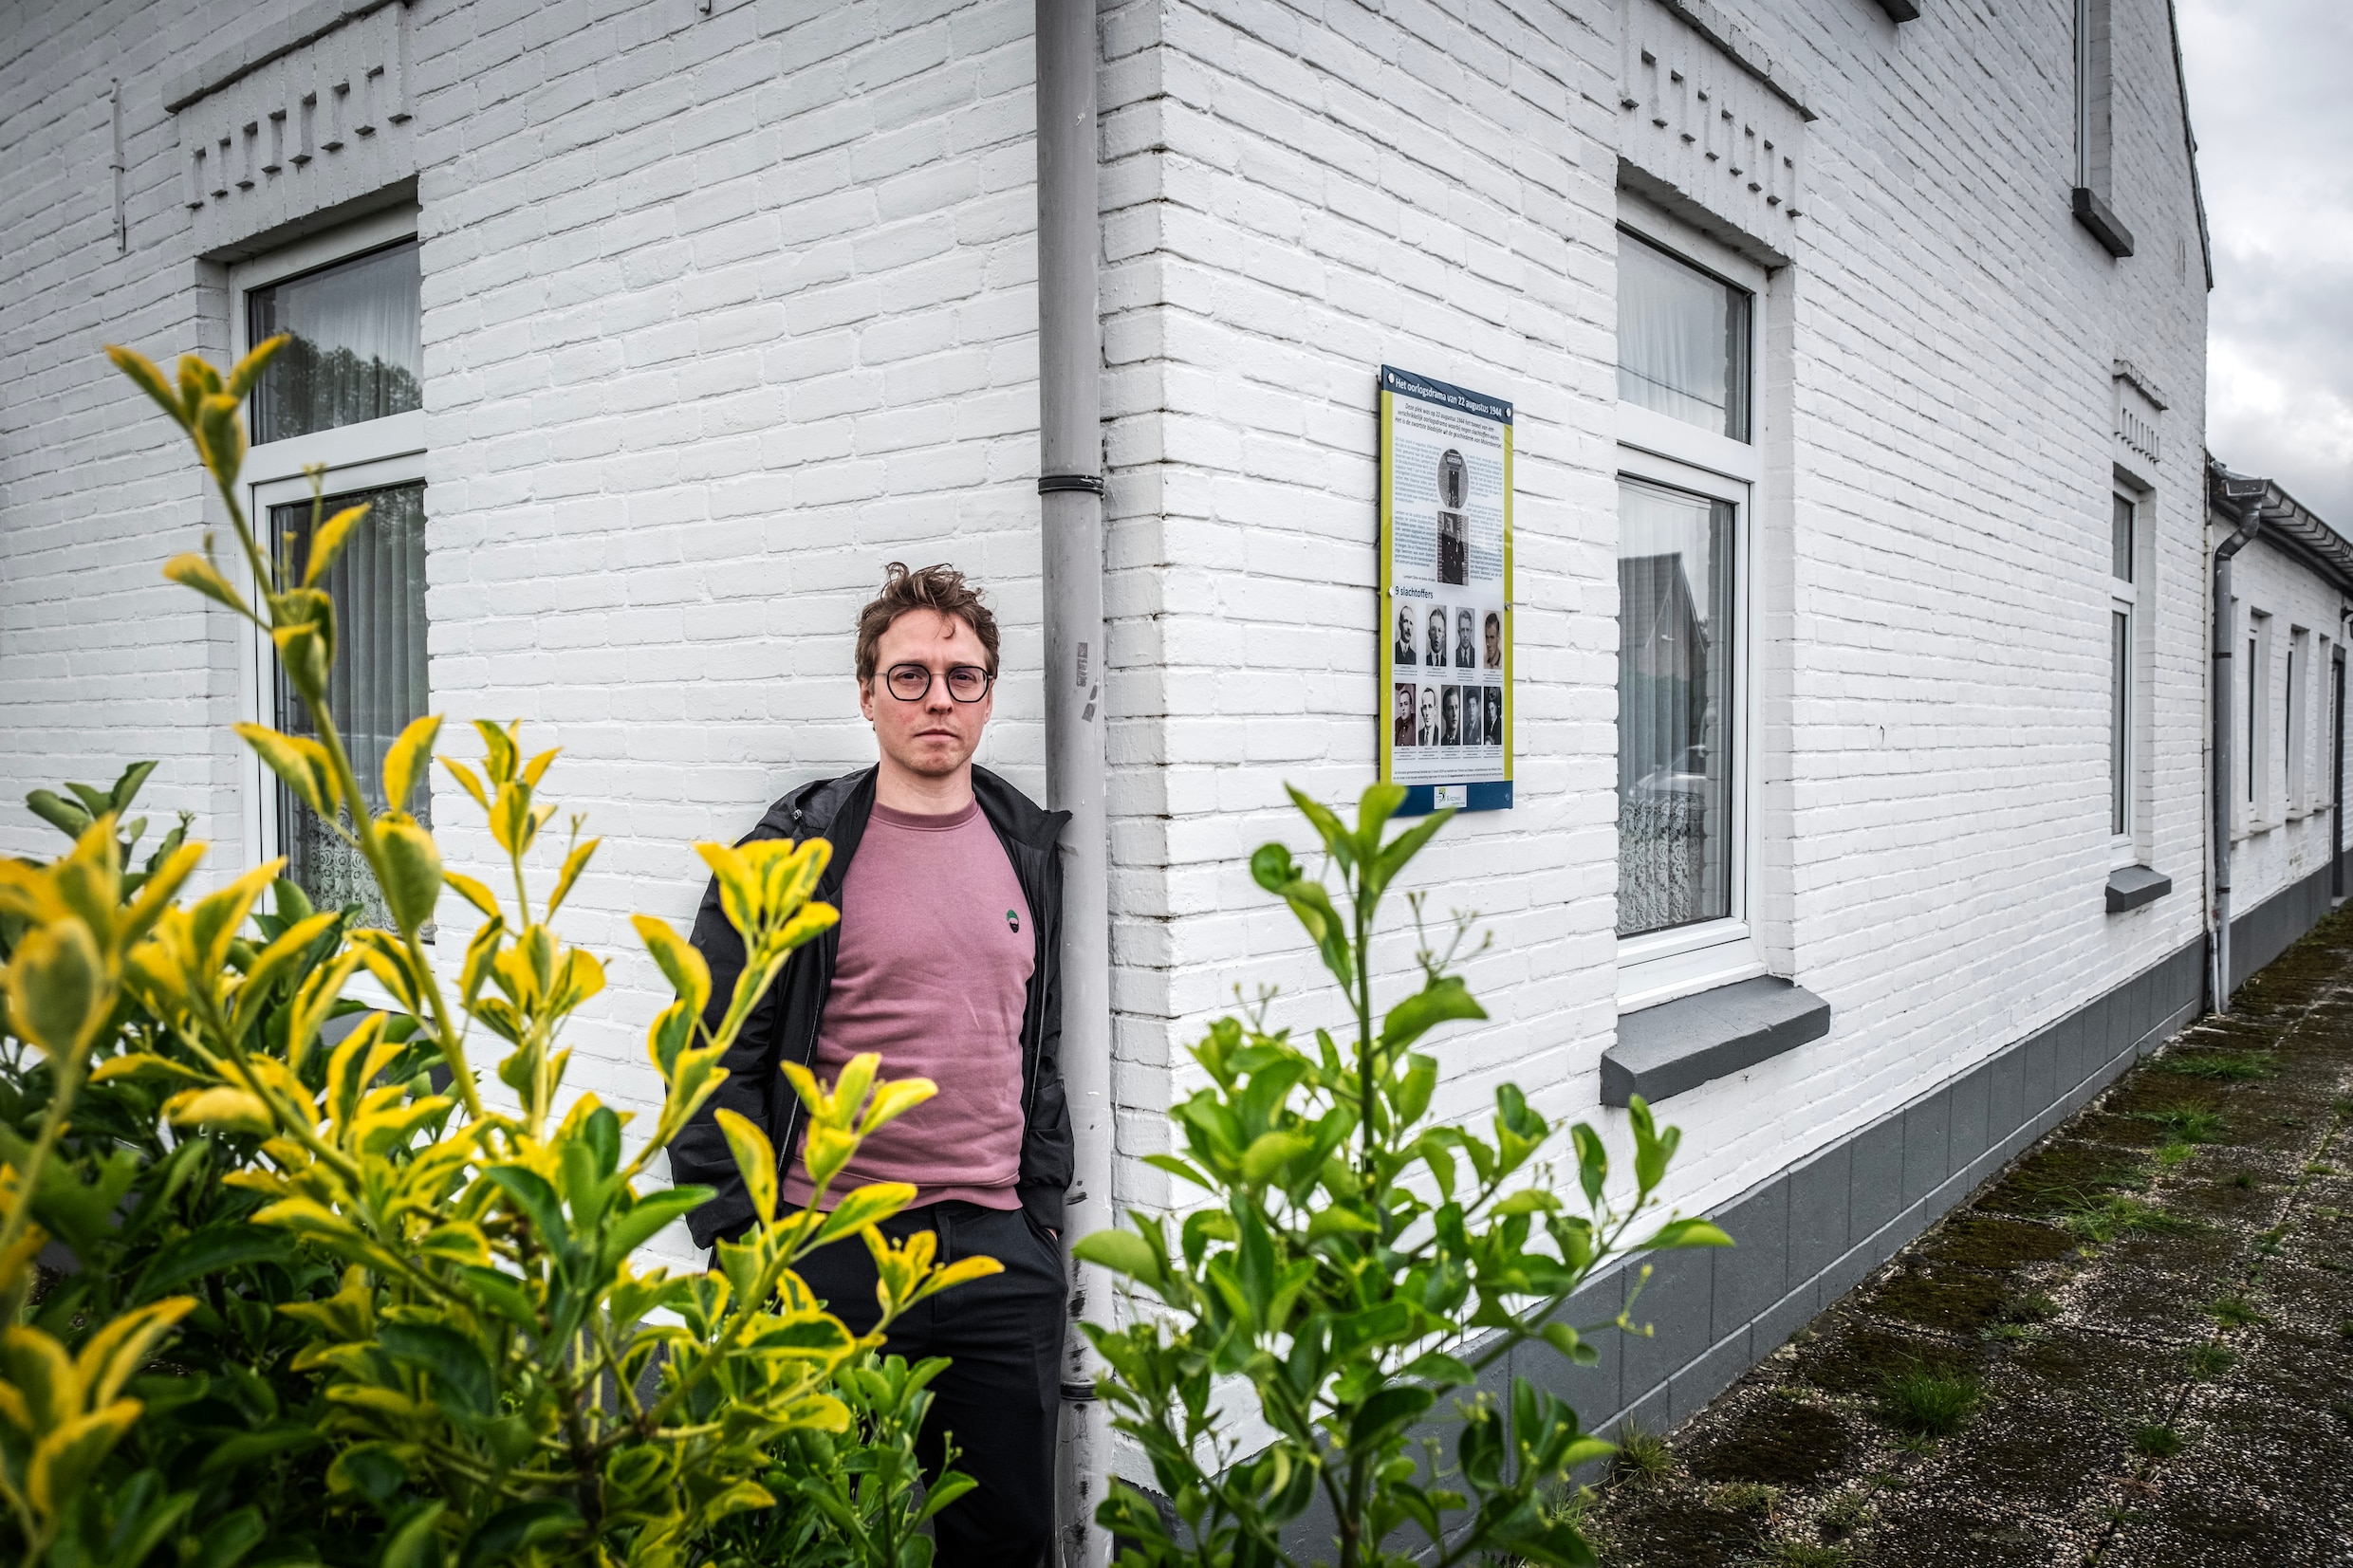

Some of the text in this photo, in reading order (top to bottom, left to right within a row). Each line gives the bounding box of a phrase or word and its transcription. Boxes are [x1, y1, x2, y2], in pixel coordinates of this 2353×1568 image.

[1395, 378, 1502, 417] Het oorlogsdrama van 22 augustus 1944
[1398, 410, 1423, 421] verschrikkelijk
[1423, 417, 1447, 427] oorlogsdrama
[1427, 425, 1442, 434] bladzijde
[1453, 432, 1474, 441] geschiedenis
[1395, 586, 1433, 599] 9 slachtoffers
